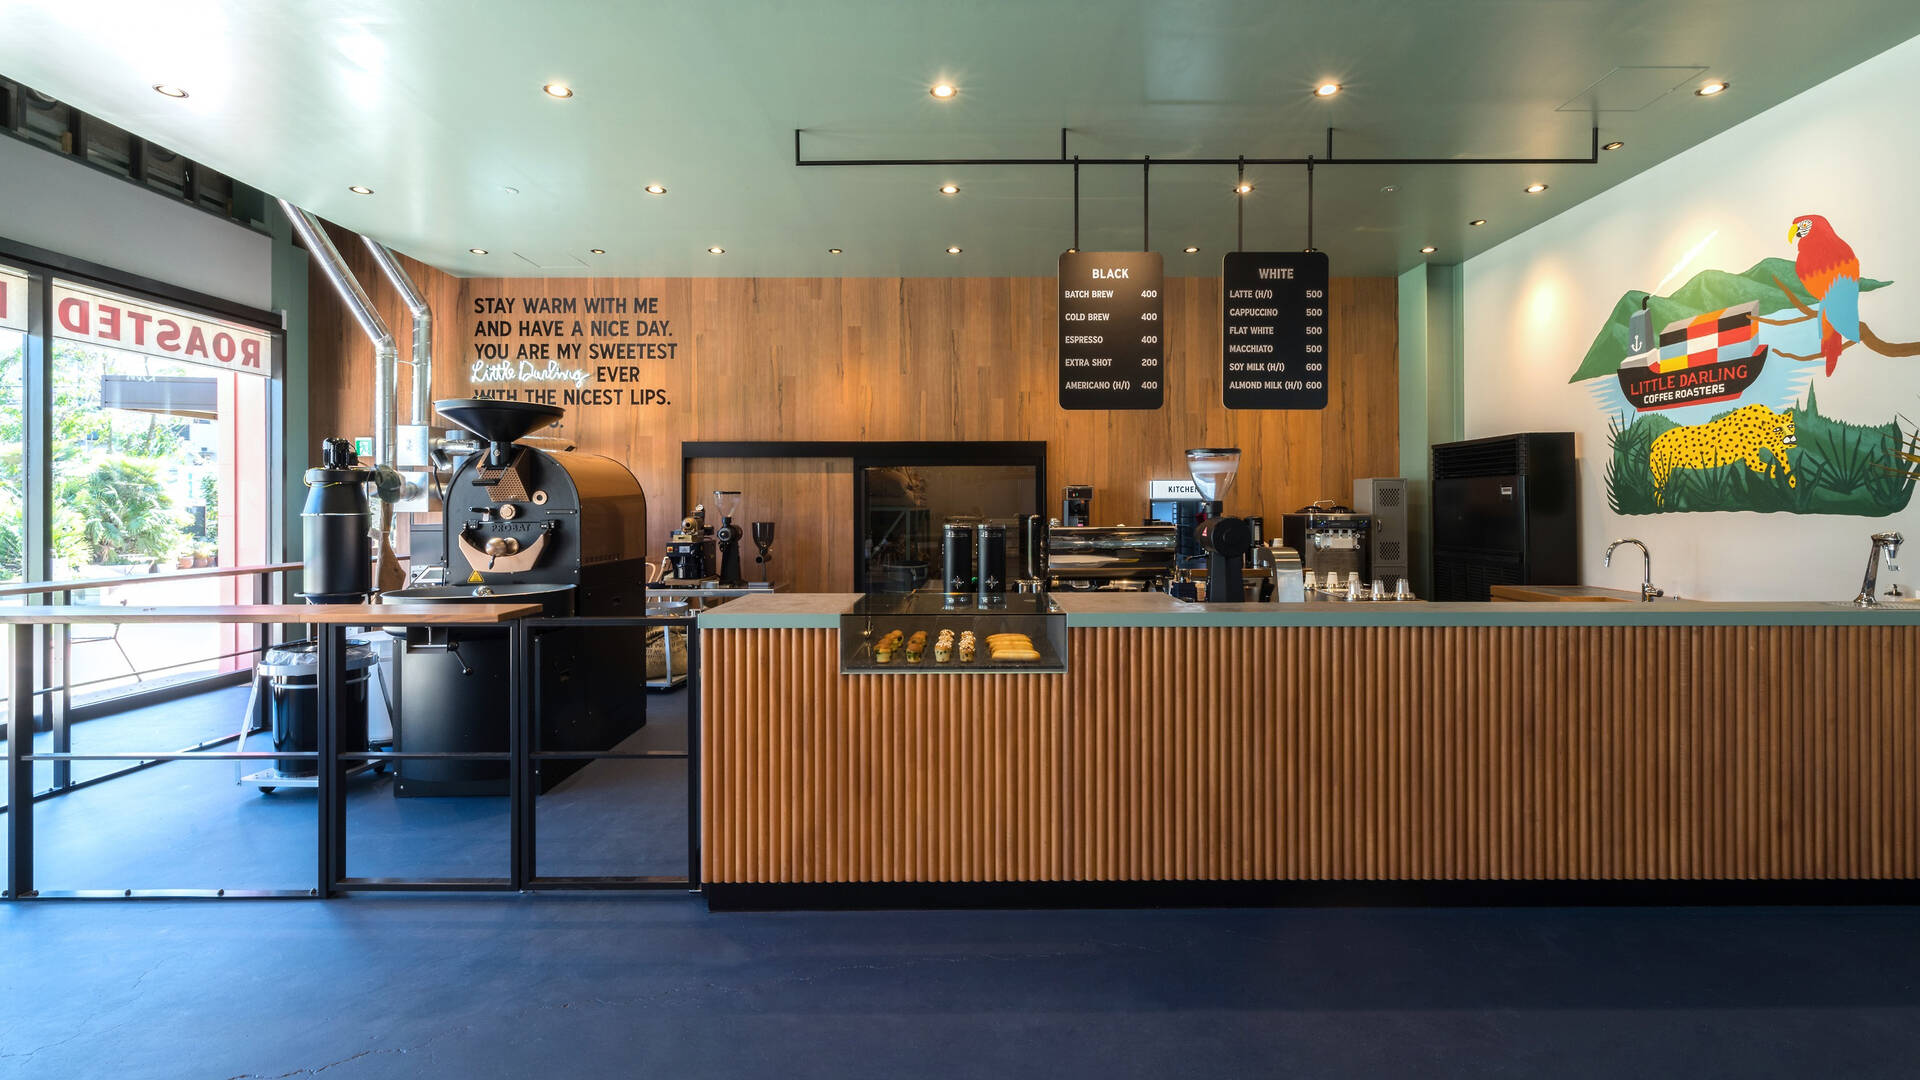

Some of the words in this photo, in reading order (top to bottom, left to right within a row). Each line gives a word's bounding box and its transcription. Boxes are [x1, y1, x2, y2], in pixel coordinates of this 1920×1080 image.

[1092, 268, 1129, 279] BLACK
[1258, 268, 1294, 279] WHITE
[1065, 290, 1089, 298] BATCH
[1092, 290, 1114, 298] BREW
[1141, 290, 1157, 298] 400
[1229, 290, 1252, 298] LATTE
[1255, 290, 1273, 299] (H/I)
[1306, 290, 1322, 298] 500
[474, 298, 515, 314] STAY
[523, 298, 576, 314] WARM
[584, 298, 626, 314] WITH
[633, 298, 658, 314] ME
[1229, 308, 1278, 316] CAPPUCCINO
[1306, 308, 1322, 316] 500
[1065, 313, 1085, 321] COLD
[1088, 313, 1110, 321] BREW
[1141, 313, 1157, 321] 400
[474, 320, 512, 337] AND
[519, 320, 564, 337] HAVE
[571, 320, 584, 337] A
[591, 320, 629, 337] NICE
[636, 320, 672, 337] DAY.
[1065, 336, 1103, 344] ESPRESSO
[1141, 336, 1157, 344] 400
[474, 343, 509, 359] YOU
[516, 343, 550, 359] ARE
[557, 343, 582, 359] MY
[589, 343, 677, 359] SWEETEST
[1229, 345, 1273, 353] MACCHIATO
[1306, 345, 1322, 353] 500
[1065, 358, 1089, 366] EXTRA
[1092, 358, 1112, 366] SHOT
[1141, 358, 1158, 366] 200
[470, 360, 516, 383] Little
[597, 366, 640, 382] EVER
[1229, 363, 1244, 371] SOY
[1247, 363, 1265, 371] MILK
[1267, 363, 1285, 372] (H/I)
[1306, 363, 1322, 371] 600
[1630, 376, 1676, 395] LITTLE
[1679, 365, 1747, 387] DARLING
[1113, 381, 1130, 390] (H/I)
[1285, 381, 1302, 390] (H/I)
[474, 390, 517, 400] WITH
[525, 390, 556, 405] THE
[563, 390, 623, 405] NICEST
[630, 390, 671, 405] LIPS.
[1643, 389, 1674, 404] COFFEE
[1675, 384, 1725, 399] ROASTERS
